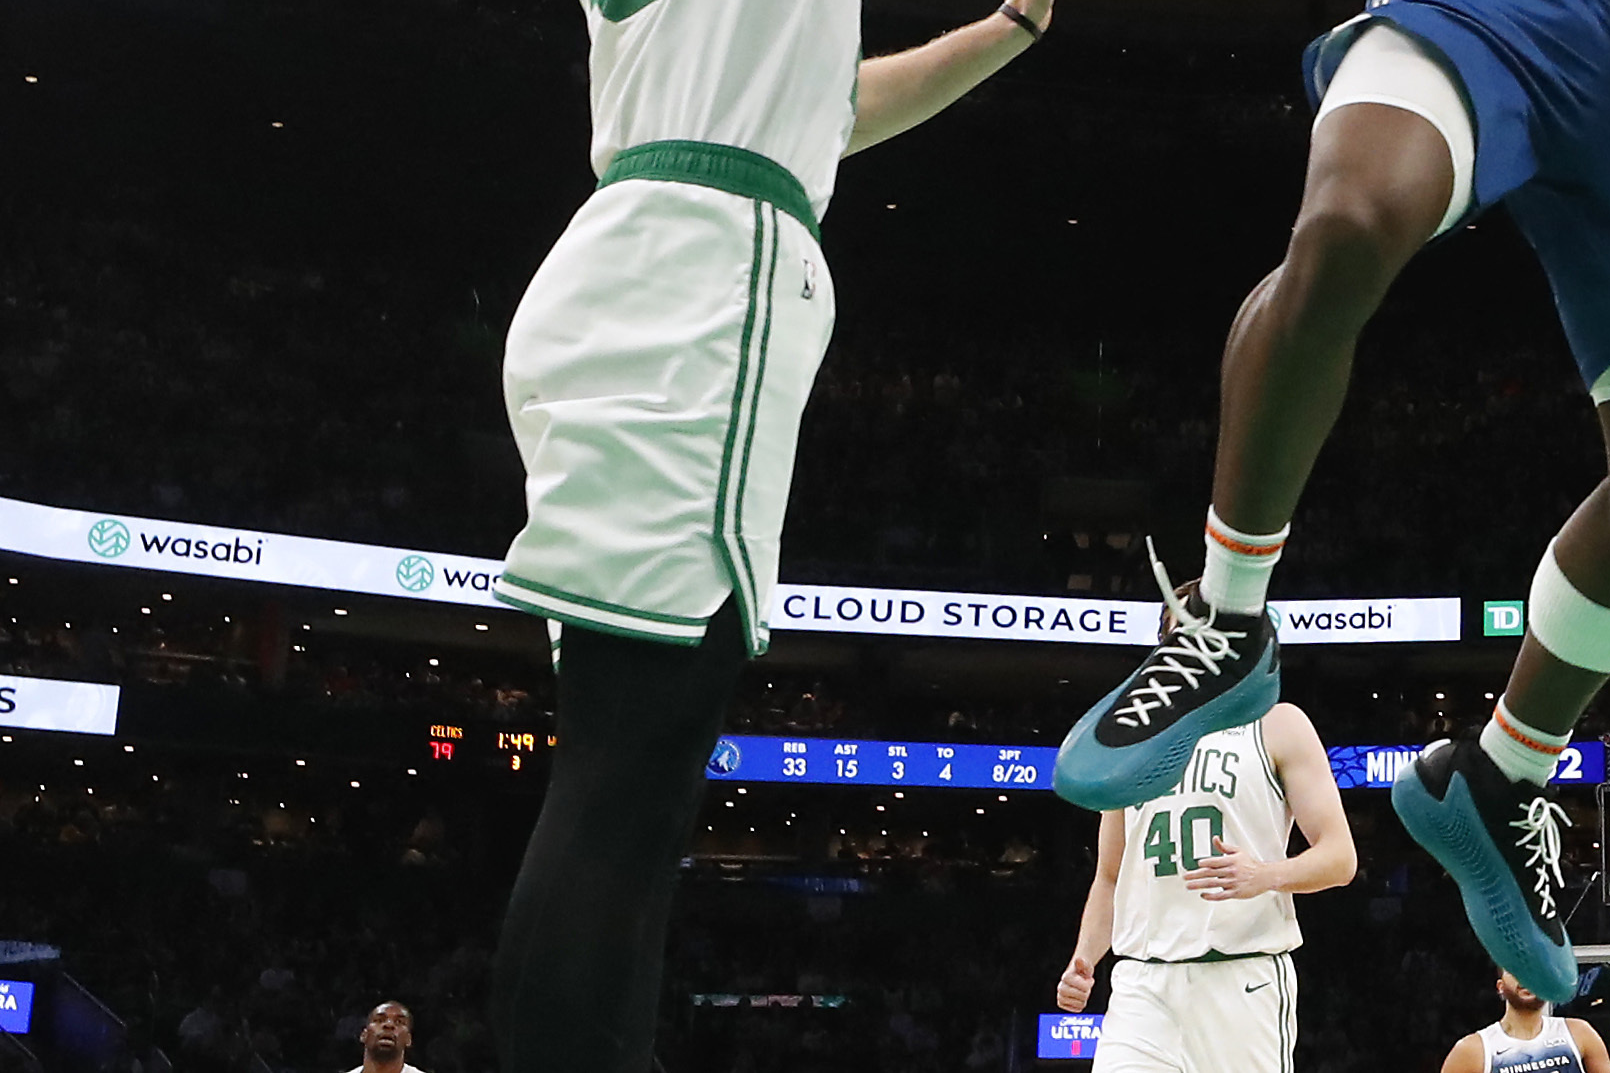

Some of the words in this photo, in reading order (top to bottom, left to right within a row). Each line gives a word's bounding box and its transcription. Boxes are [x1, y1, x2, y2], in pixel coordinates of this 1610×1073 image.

[141, 533, 263, 565] wasabi
[783, 594, 925, 624] CLOUD
[943, 602, 1127, 634] STORAGE
[1289, 605, 1392, 630] wasabi
[1487, 607, 1520, 630] TD
[431, 725, 463, 739] CELTICS
[498, 732, 534, 751] 1:49
[429, 741, 454, 760] 79
[784, 742, 806, 754] REB
[834, 744, 858, 755] AST
[888, 746, 908, 757] STL
[937, 747, 954, 759] TO
[999, 749, 1021, 761] 3PT
[512, 755, 521, 770] 3
[782, 758, 806, 776] 33
[835, 759, 858, 778] 15
[892, 761, 904, 779] 3
[939, 763, 952, 781] 4
[992, 764, 1037, 784] 8/20
[1144, 805, 1224, 877] 40
[1051, 1026, 1102, 1039] ULTRA
